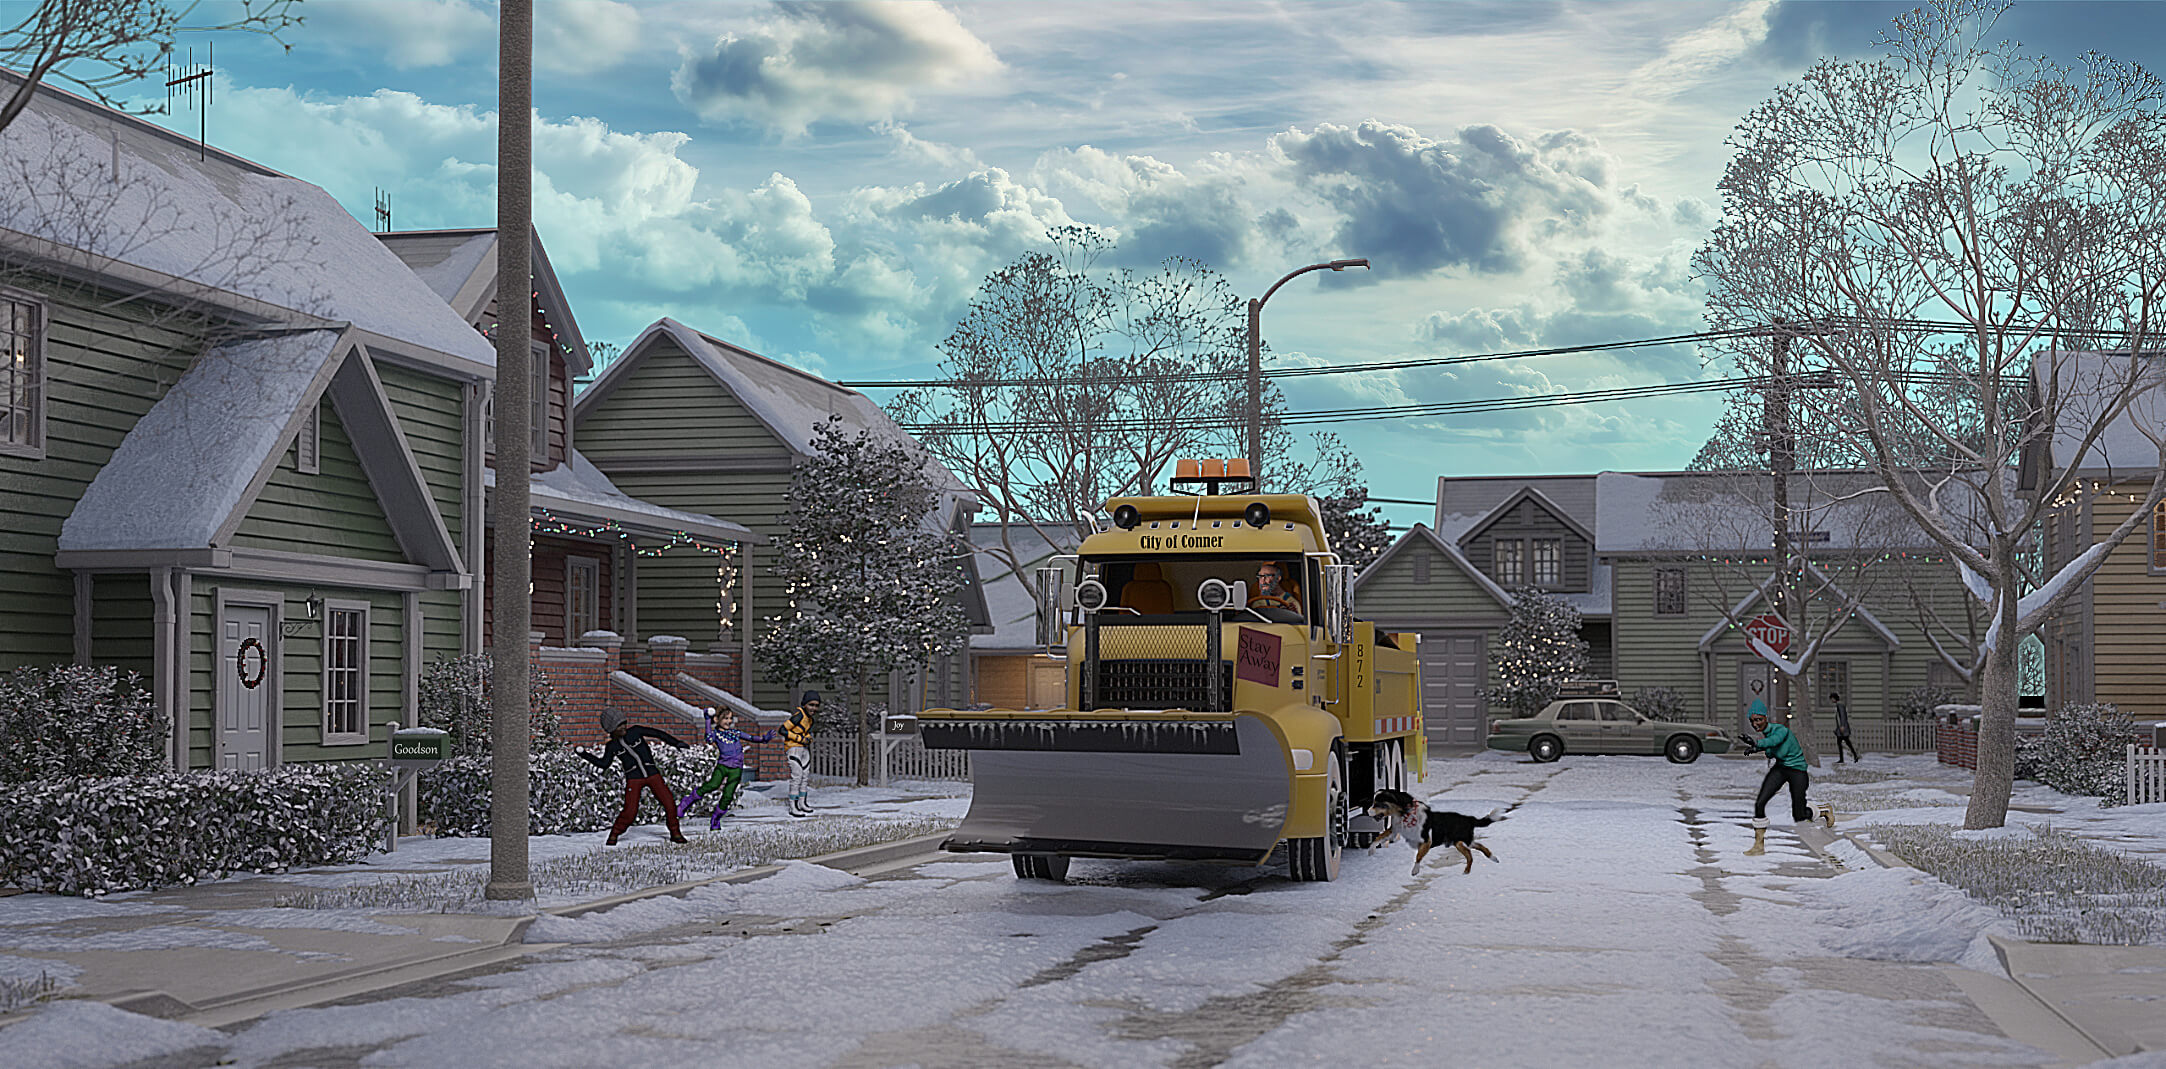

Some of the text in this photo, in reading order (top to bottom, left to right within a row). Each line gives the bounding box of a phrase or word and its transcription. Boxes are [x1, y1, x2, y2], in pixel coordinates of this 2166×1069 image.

[1140, 534, 1224, 550] City of Conner
[1240, 633, 1272, 660] Stay
[1239, 649, 1281, 677] Away
[892, 720, 905, 731] Joy
[394, 741, 438, 755] Goodson
